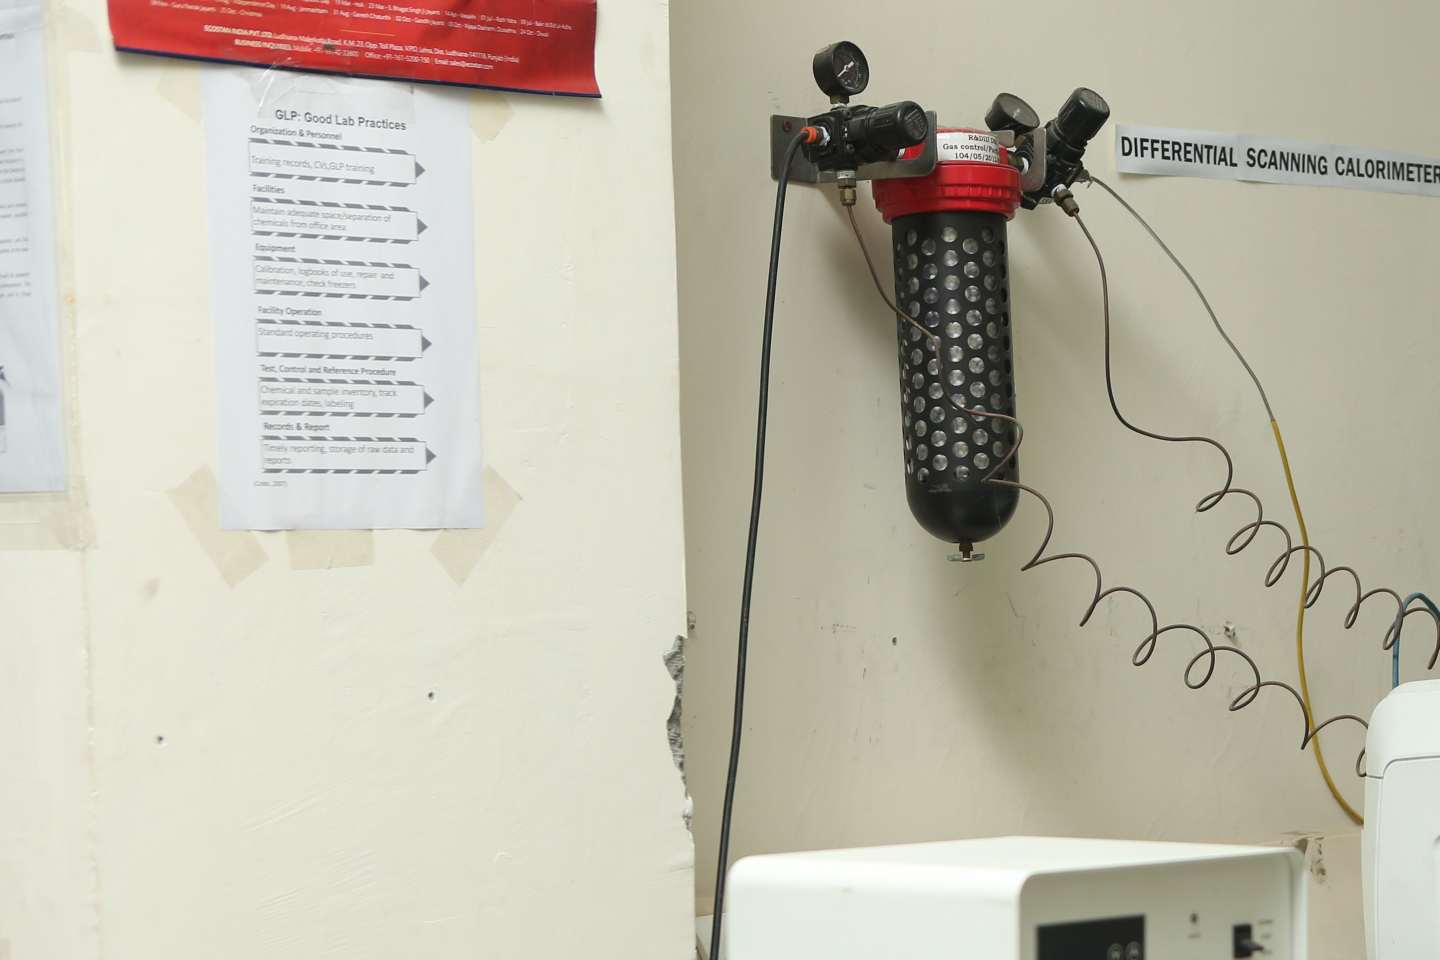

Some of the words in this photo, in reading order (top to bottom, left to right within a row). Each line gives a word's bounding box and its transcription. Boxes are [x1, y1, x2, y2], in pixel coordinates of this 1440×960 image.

[276, 109, 301, 121] GLP:
[304, 112, 332, 124] Good
[335, 115, 354, 126] Lab
[359, 117, 406, 131] Practices
[250, 125, 296, 137] Organization
[299, 129, 304, 138] &
[307, 130, 342, 140] Personnel
[1120, 135, 1239, 168] DIFFERENTIAL
[1246, 147, 1329, 176] SCANNING
[252, 156, 281, 168] Training
[253, 184, 285, 194] Facilities
[256, 243, 296, 252] Equipment
[258, 306, 284, 315] Facility
[286, 307, 322, 316] Operation
[257, 328, 293, 338] Standard
[279, 365, 306, 374] Control
[308, 366, 321, 374] and
[323, 367, 359, 376] Reference
[361, 368, 396, 376] Procedure
[264, 422, 294, 431] Records
